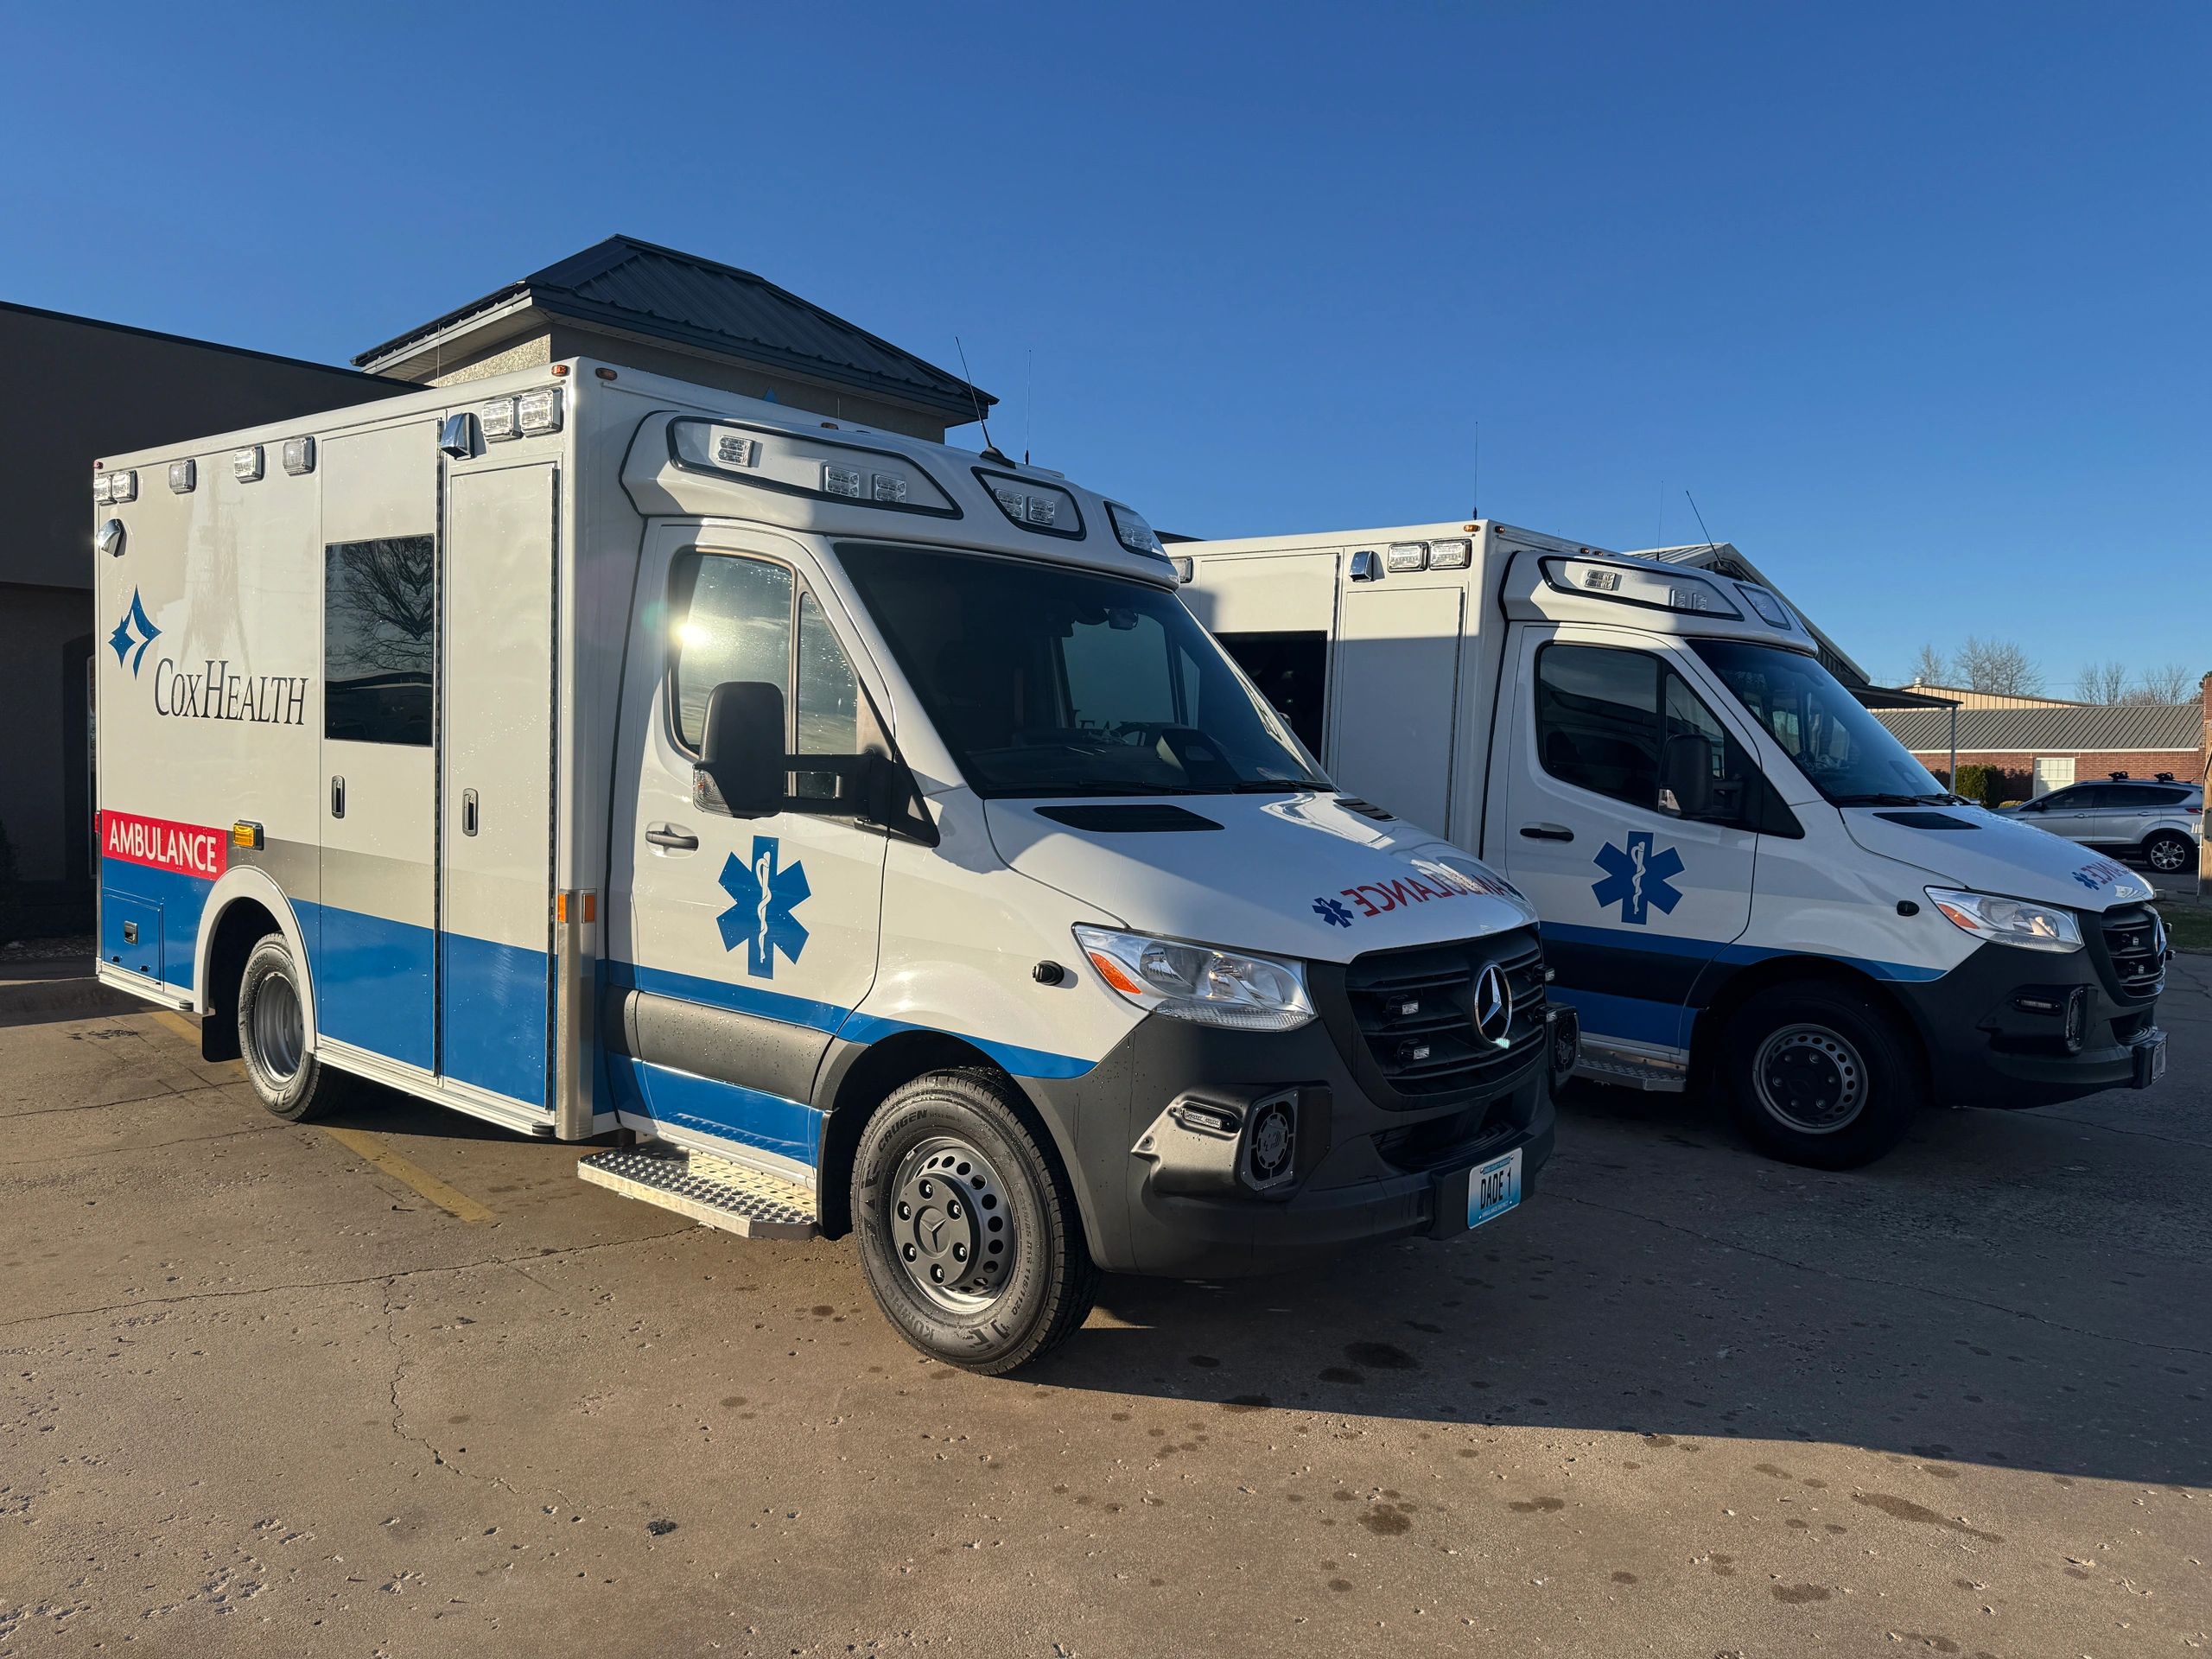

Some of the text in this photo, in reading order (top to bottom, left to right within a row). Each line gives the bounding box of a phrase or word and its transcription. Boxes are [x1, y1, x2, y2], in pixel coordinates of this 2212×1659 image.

[108, 819, 218, 874] AMBULANCE
[878, 1109, 928, 1153] CRUGEN
[1480, 1171, 1504, 1210] DADE
[1507, 1166, 1512, 1198] 1
